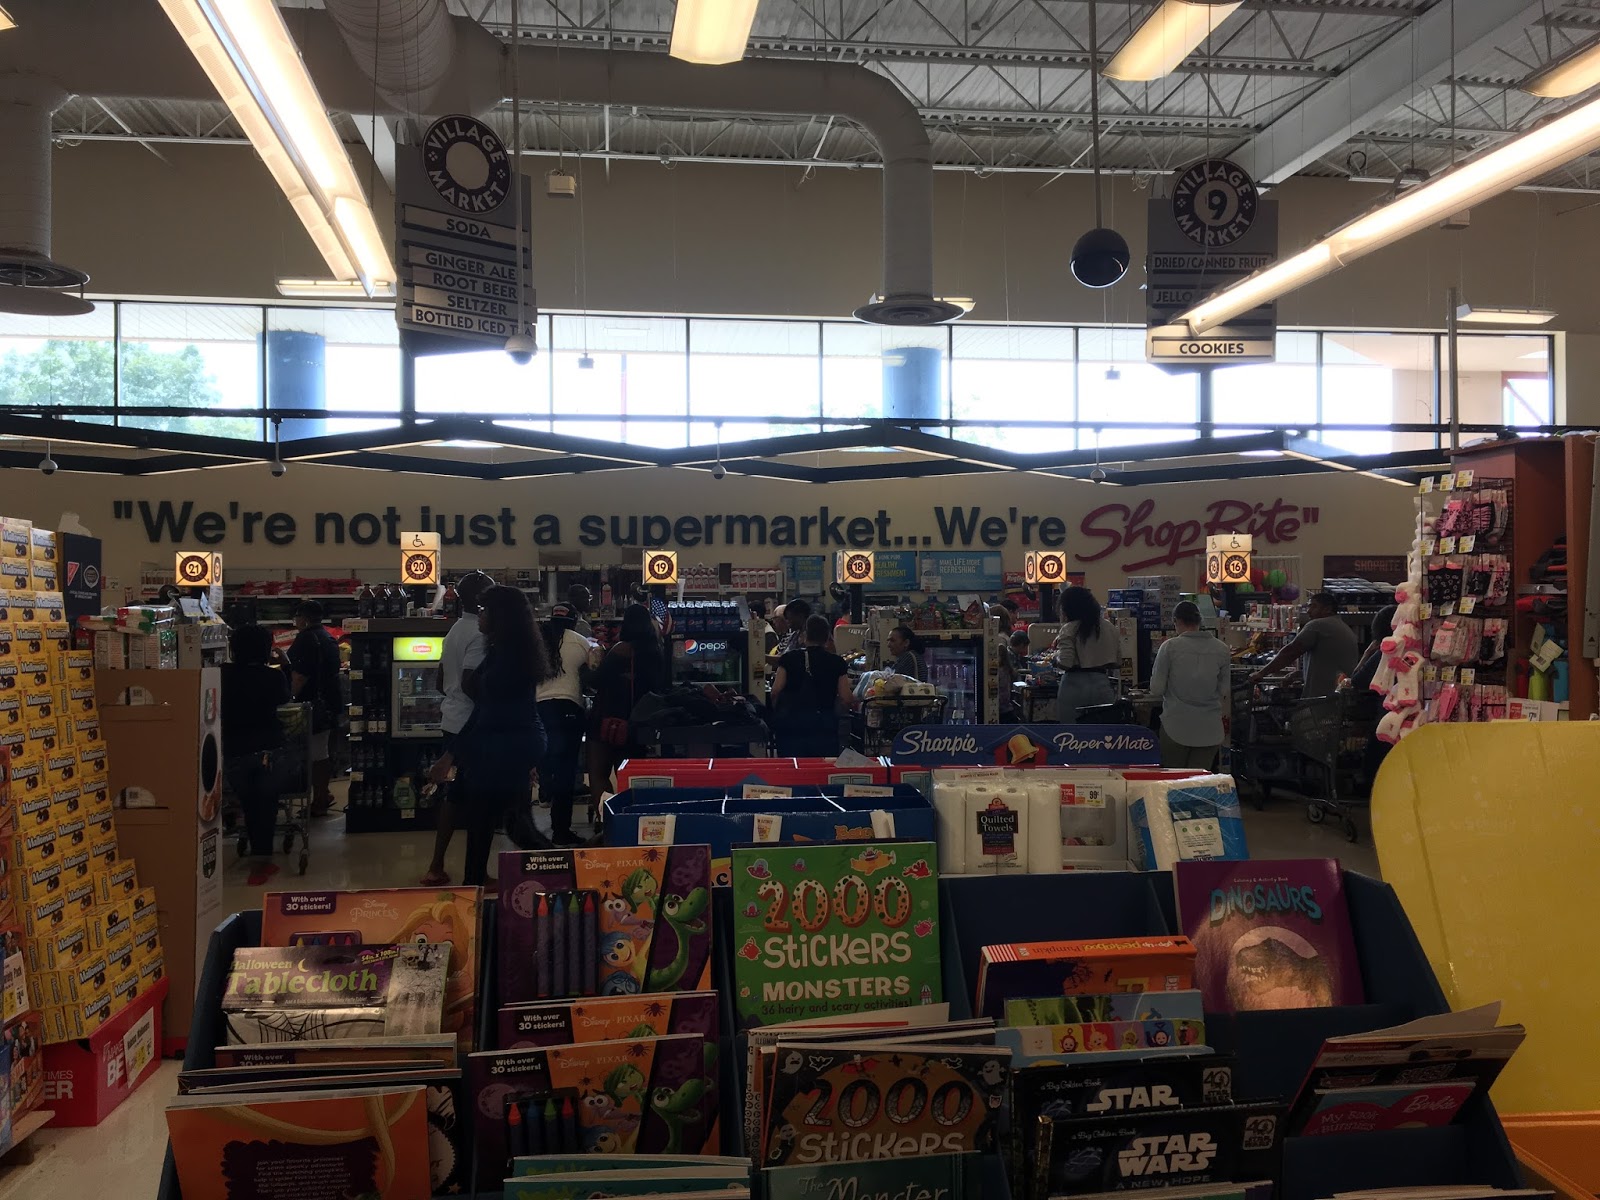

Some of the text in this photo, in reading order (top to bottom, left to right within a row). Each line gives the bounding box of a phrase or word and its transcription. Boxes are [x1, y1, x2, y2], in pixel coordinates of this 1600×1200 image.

[428, 119, 505, 163] VILLAGE
[1177, 164, 1251, 197] VILLAGE
[429, 170, 504, 212] MARKET
[1207, 189, 1228, 221] 9
[446, 218, 491, 239] SODA
[1177, 212, 1250, 245] MARKET
[426, 252, 516, 280] GINGER ALE
[1154, 256, 1268, 268] DRIED/CANNED FRUIT
[433, 273, 517, 299] ROOT BEER
[1156, 291, 1193, 303] JELLO
[447, 295, 507, 316] SELTZER
[415, 309, 533, 338] BOTTLED ICED TA
[1179, 343, 1245, 354] COOKIES
[113, 500, 296, 546] "We're
[315, 506, 400, 546] not
[419, 506, 516, 546] just
[533, 513, 562, 546] a
[188, 563, 199, 574] 21
[413, 562, 425, 571] 20
[655, 562, 667, 572] 19
[853, 562, 865, 571] 18
[953, 558, 966, 566] LIFE
[1046, 563, 1055, 572] 17
[1231, 562, 1241, 571] 16
[939, 566, 976, 574] REFRESHING
[896, 730, 1153, 756] Sharpie Paper Mate
[980, 815, 1015, 825] Quilted
[982, 824, 1013, 832] Towels
[525, 862, 569, 871] 30 stickers!
[291, 895, 308, 903] With
[757, 874, 913, 933] 2000
[1210, 884, 1323, 926] DINOSAURS
[300, 902, 332, 911] stickers!
[227, 970, 378, 995] Tablecloth
[763, 976, 910, 1002] MONSTERS
[762, 1005, 774, 1014] 36
[778, 1003, 804, 1016] hairy
[809, 1002, 828, 1012] and
[832, 1002, 860, 1015] scary
[518, 1021, 565, 1030] 30 stickers!
[617, 1014, 646, 1023] PIXAR
[596, 1055, 628, 1064] PIXAR
[491, 1064, 541, 1074] 30 stickers!
[1084, 1078, 1102, 1086] Book
[44, 1081, 73, 1100] ER
[802, 1077, 973, 1128] 2000
[1087, 1084, 1180, 1112] STAR
[1118, 1132, 1218, 1158] STAR
[1118, 1151, 1217, 1177] WARS
[800, 1176, 825, 1194] The
[1116, 1175, 1211, 1189] A NEW HOPE
